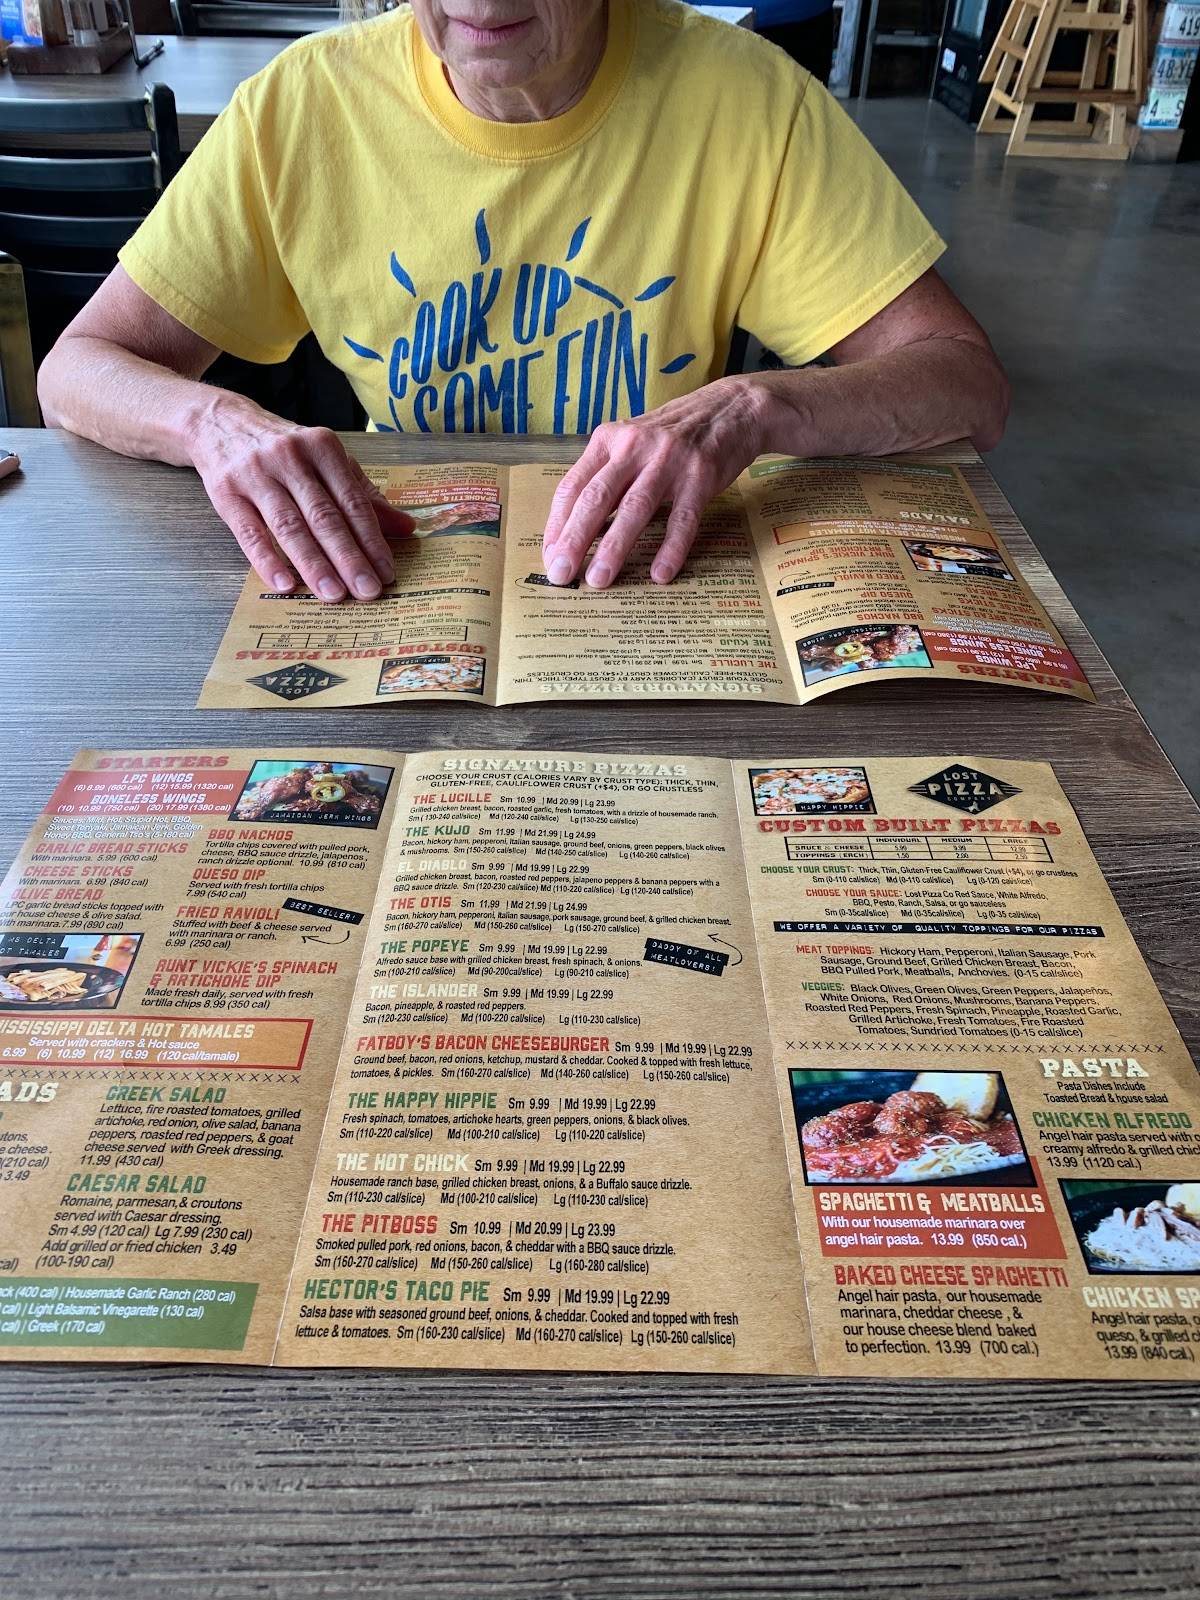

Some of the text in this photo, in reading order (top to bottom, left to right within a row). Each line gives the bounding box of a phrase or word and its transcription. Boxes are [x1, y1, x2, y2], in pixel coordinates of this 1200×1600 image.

[389, 263, 571, 399] COOK UP
[414, 309, 648, 434] SOME FUN
[899, 511, 969, 525] SALADS
[697, 578, 756, 587] THE POPEYE
[833, 573, 905, 582] FRIED RAVIOLI
[880, 591, 913, 599] QUESO
[717, 600, 761, 608] THE OTIS
[856, 613, 924, 622] BBQ NACHOS
[720, 639, 772, 647] THE KUJO
[950, 638, 1044, 657] BONELESS WINGS
[235, 643, 487, 660] CUSTOM BUILT PIZZAS
[710, 659, 777, 668] THE LUCILLE
[975, 654, 1037, 671] LPC WINGS
[264, 675, 330, 686] PIZZA
[956, 664, 1073, 690] STARTERS
[277, 687, 310, 696] LOST
[539, 682, 764, 694] SIGNATURE PIZZAS
[98, 756, 230, 769] STARTERS
[442, 759, 688, 777] SIGNATURE PIZZAS
[122, 773, 193, 783] LPC WINGS
[943, 772, 978, 781] LOST
[928, 784, 1003, 796] PIZZA
[91, 794, 207, 804] BONELESS WINGS
[413, 792, 492, 804] THE LUCILLE
[406, 825, 471, 837] THE KUJO
[758, 819, 1062, 835] CUSTOM BUILT PIZZAS
[208, 829, 294, 840] BBQ NACHOS
[35, 843, 189, 854] GARLIC BREAD STICKS
[205, 841, 370, 854] Tortilla chips covered with pulled pork,
[24, 866, 134, 876] CHEESE STICKS
[398, 859, 466, 872] EL DIABLO
[761, 866, 854, 874] CHOOSE YOUR CRUST:
[192, 869, 266, 880] QUESO DIP
[806, 889, 902, 898] CHOOSE YOUR SAUCE:
[390, 897, 452, 909] THE OTIS
[177, 906, 280, 920] FRIED RAVIOLI
[290, 901, 357, 921] BEST SELLER!
[381, 939, 470, 953] THE POPEYE
[652, 941, 681, 954] DADDY
[704, 952, 722, 961] ALL
[796, 945, 874, 955] MEAT TOPPINGS:
[650, 952, 716, 972] MEATLOVERS!
[370, 984, 478, 998] THE ISLANDER
[801, 982, 845, 991] VEGGIES:
[86, 1021, 136, 1036] DELTA
[142, 1023, 174, 1037] HOT
[180, 1023, 255, 1039] TAMALES
[357, 1035, 610, 1052] FATBOY'S BACON CHEESEBURGER
[1039, 1058, 1150, 1079] PASTA
[106, 1085, 227, 1103] GREEK SALAD
[348, 1092, 497, 1109] THE HAPPY HIPPIE
[1033, 1112, 1192, 1128] CHICKEN ALFREDO
[80, 1155, 164, 1167] 11.99 (430 cal)
[336, 1154, 469, 1172] THE HOT CHICK
[1047, 1156, 1142, 1170] 13.99 (1120 cal.)
[66, 1174, 207, 1193] CAESAR SALAD
[819, 1191, 1045, 1214] SPAGHETTI & MEATBALLS
[322, 1214, 438, 1234] THE PITBOSS
[42, 1240, 237, 1255] Add grilled or fried chicken 3.49
[316, 1238, 676, 1256] Smoked pulled pork, red onions, bacon, & cheddar with a BBQ sauce drizzle.
[834, 1264, 1069, 1287] BAKED CHEESE SPAGHETTI
[304, 1279, 491, 1302] HECTOR'S TACO PIE
